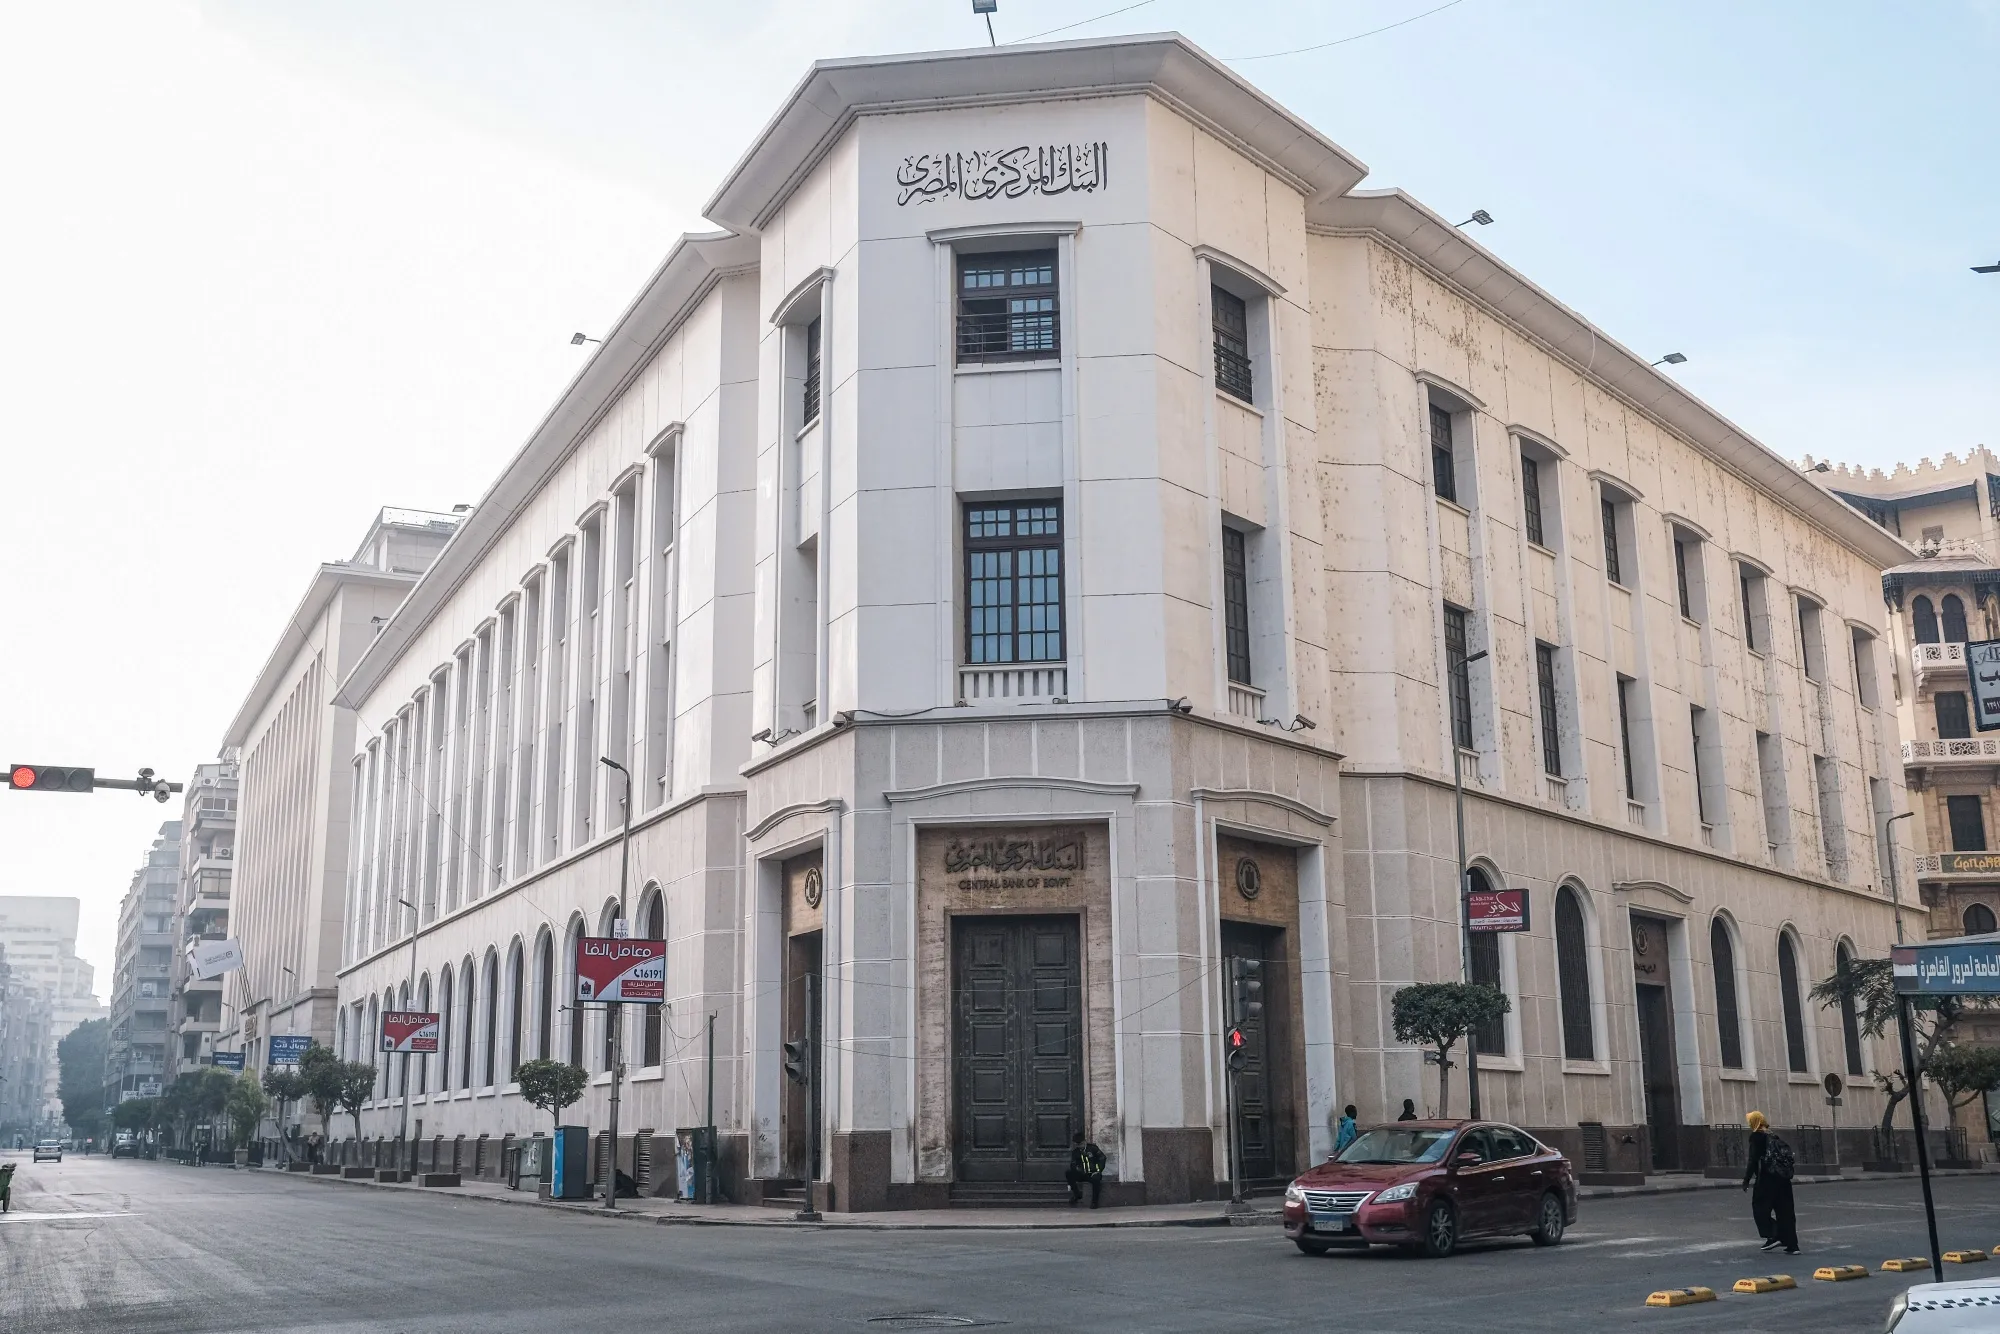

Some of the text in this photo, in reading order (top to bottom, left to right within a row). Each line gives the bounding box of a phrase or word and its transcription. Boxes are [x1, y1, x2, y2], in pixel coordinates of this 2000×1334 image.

[1041, 141, 1109, 196] البنك
[958, 877, 1071, 890] CENTRAL BANK OF EGYPT
[585, 942, 652, 961] معامل الفا
[640, 969, 662, 979] 16191
[1920, 956, 1951, 984] القاهرة
[1952, 955, 1974, 984] لمرور
[388, 1014, 431, 1025] معامل الفا
